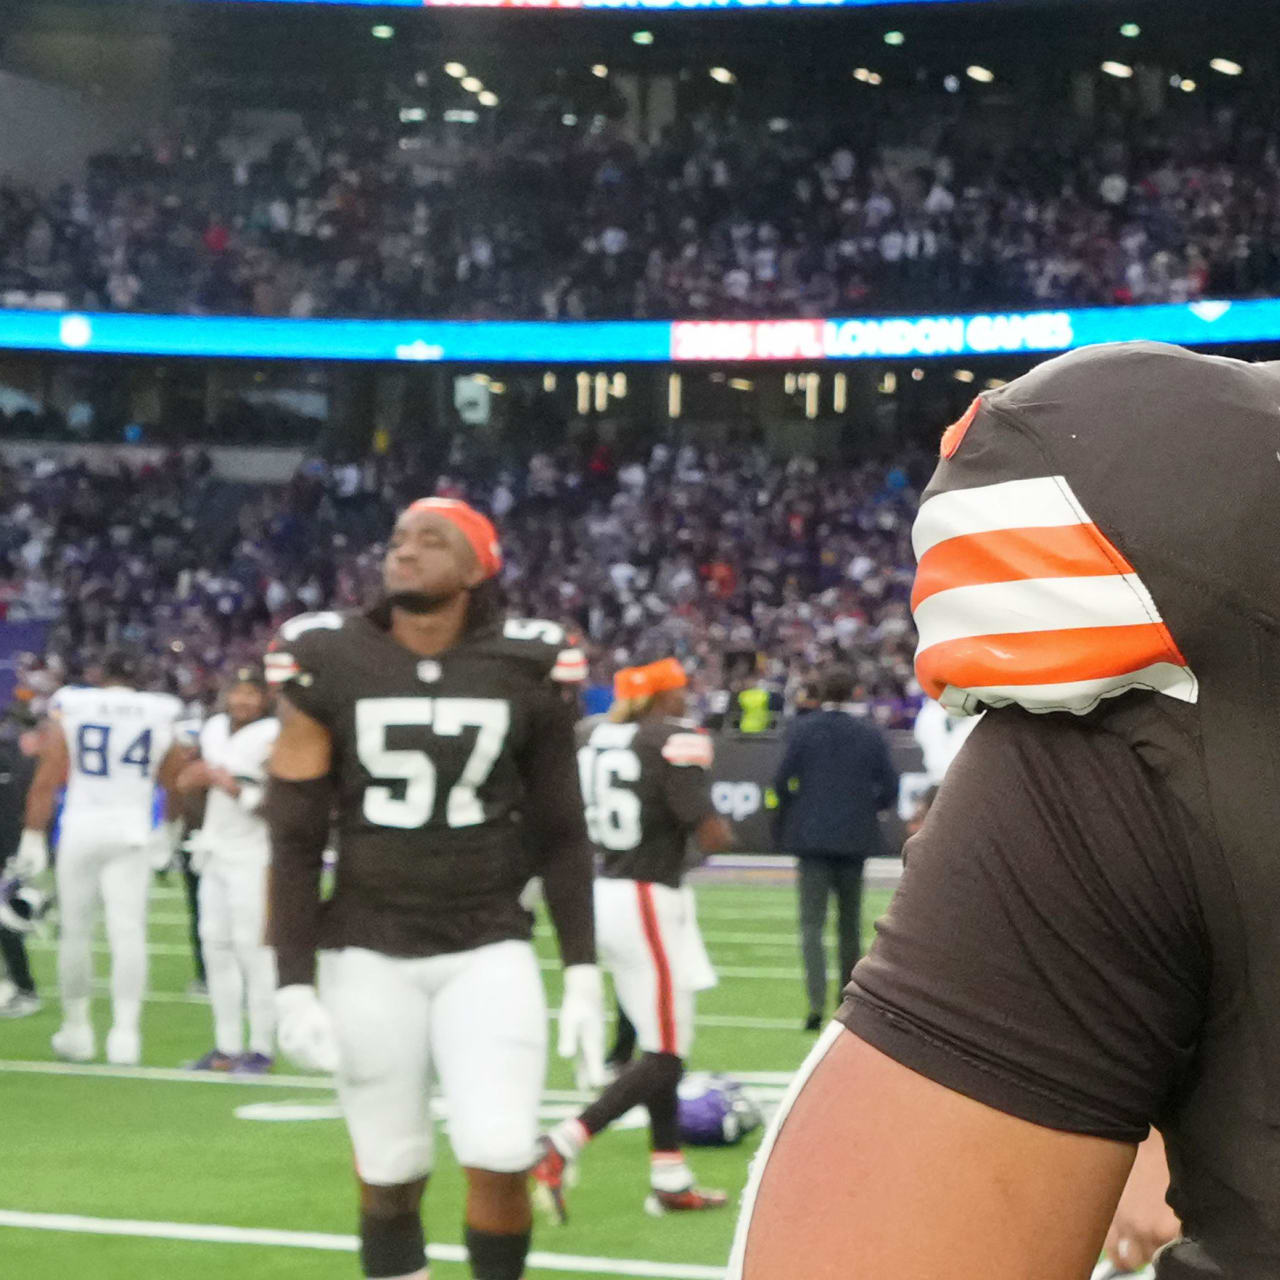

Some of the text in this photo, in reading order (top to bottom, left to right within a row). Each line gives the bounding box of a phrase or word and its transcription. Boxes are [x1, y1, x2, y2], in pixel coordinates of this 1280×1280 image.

[756, 321, 823, 358] NFL
[824, 318, 962, 355] LONDON
[966, 313, 1072, 351] GAMES
[78, 723, 153, 778] 84
[355, 697, 511, 829] 57
